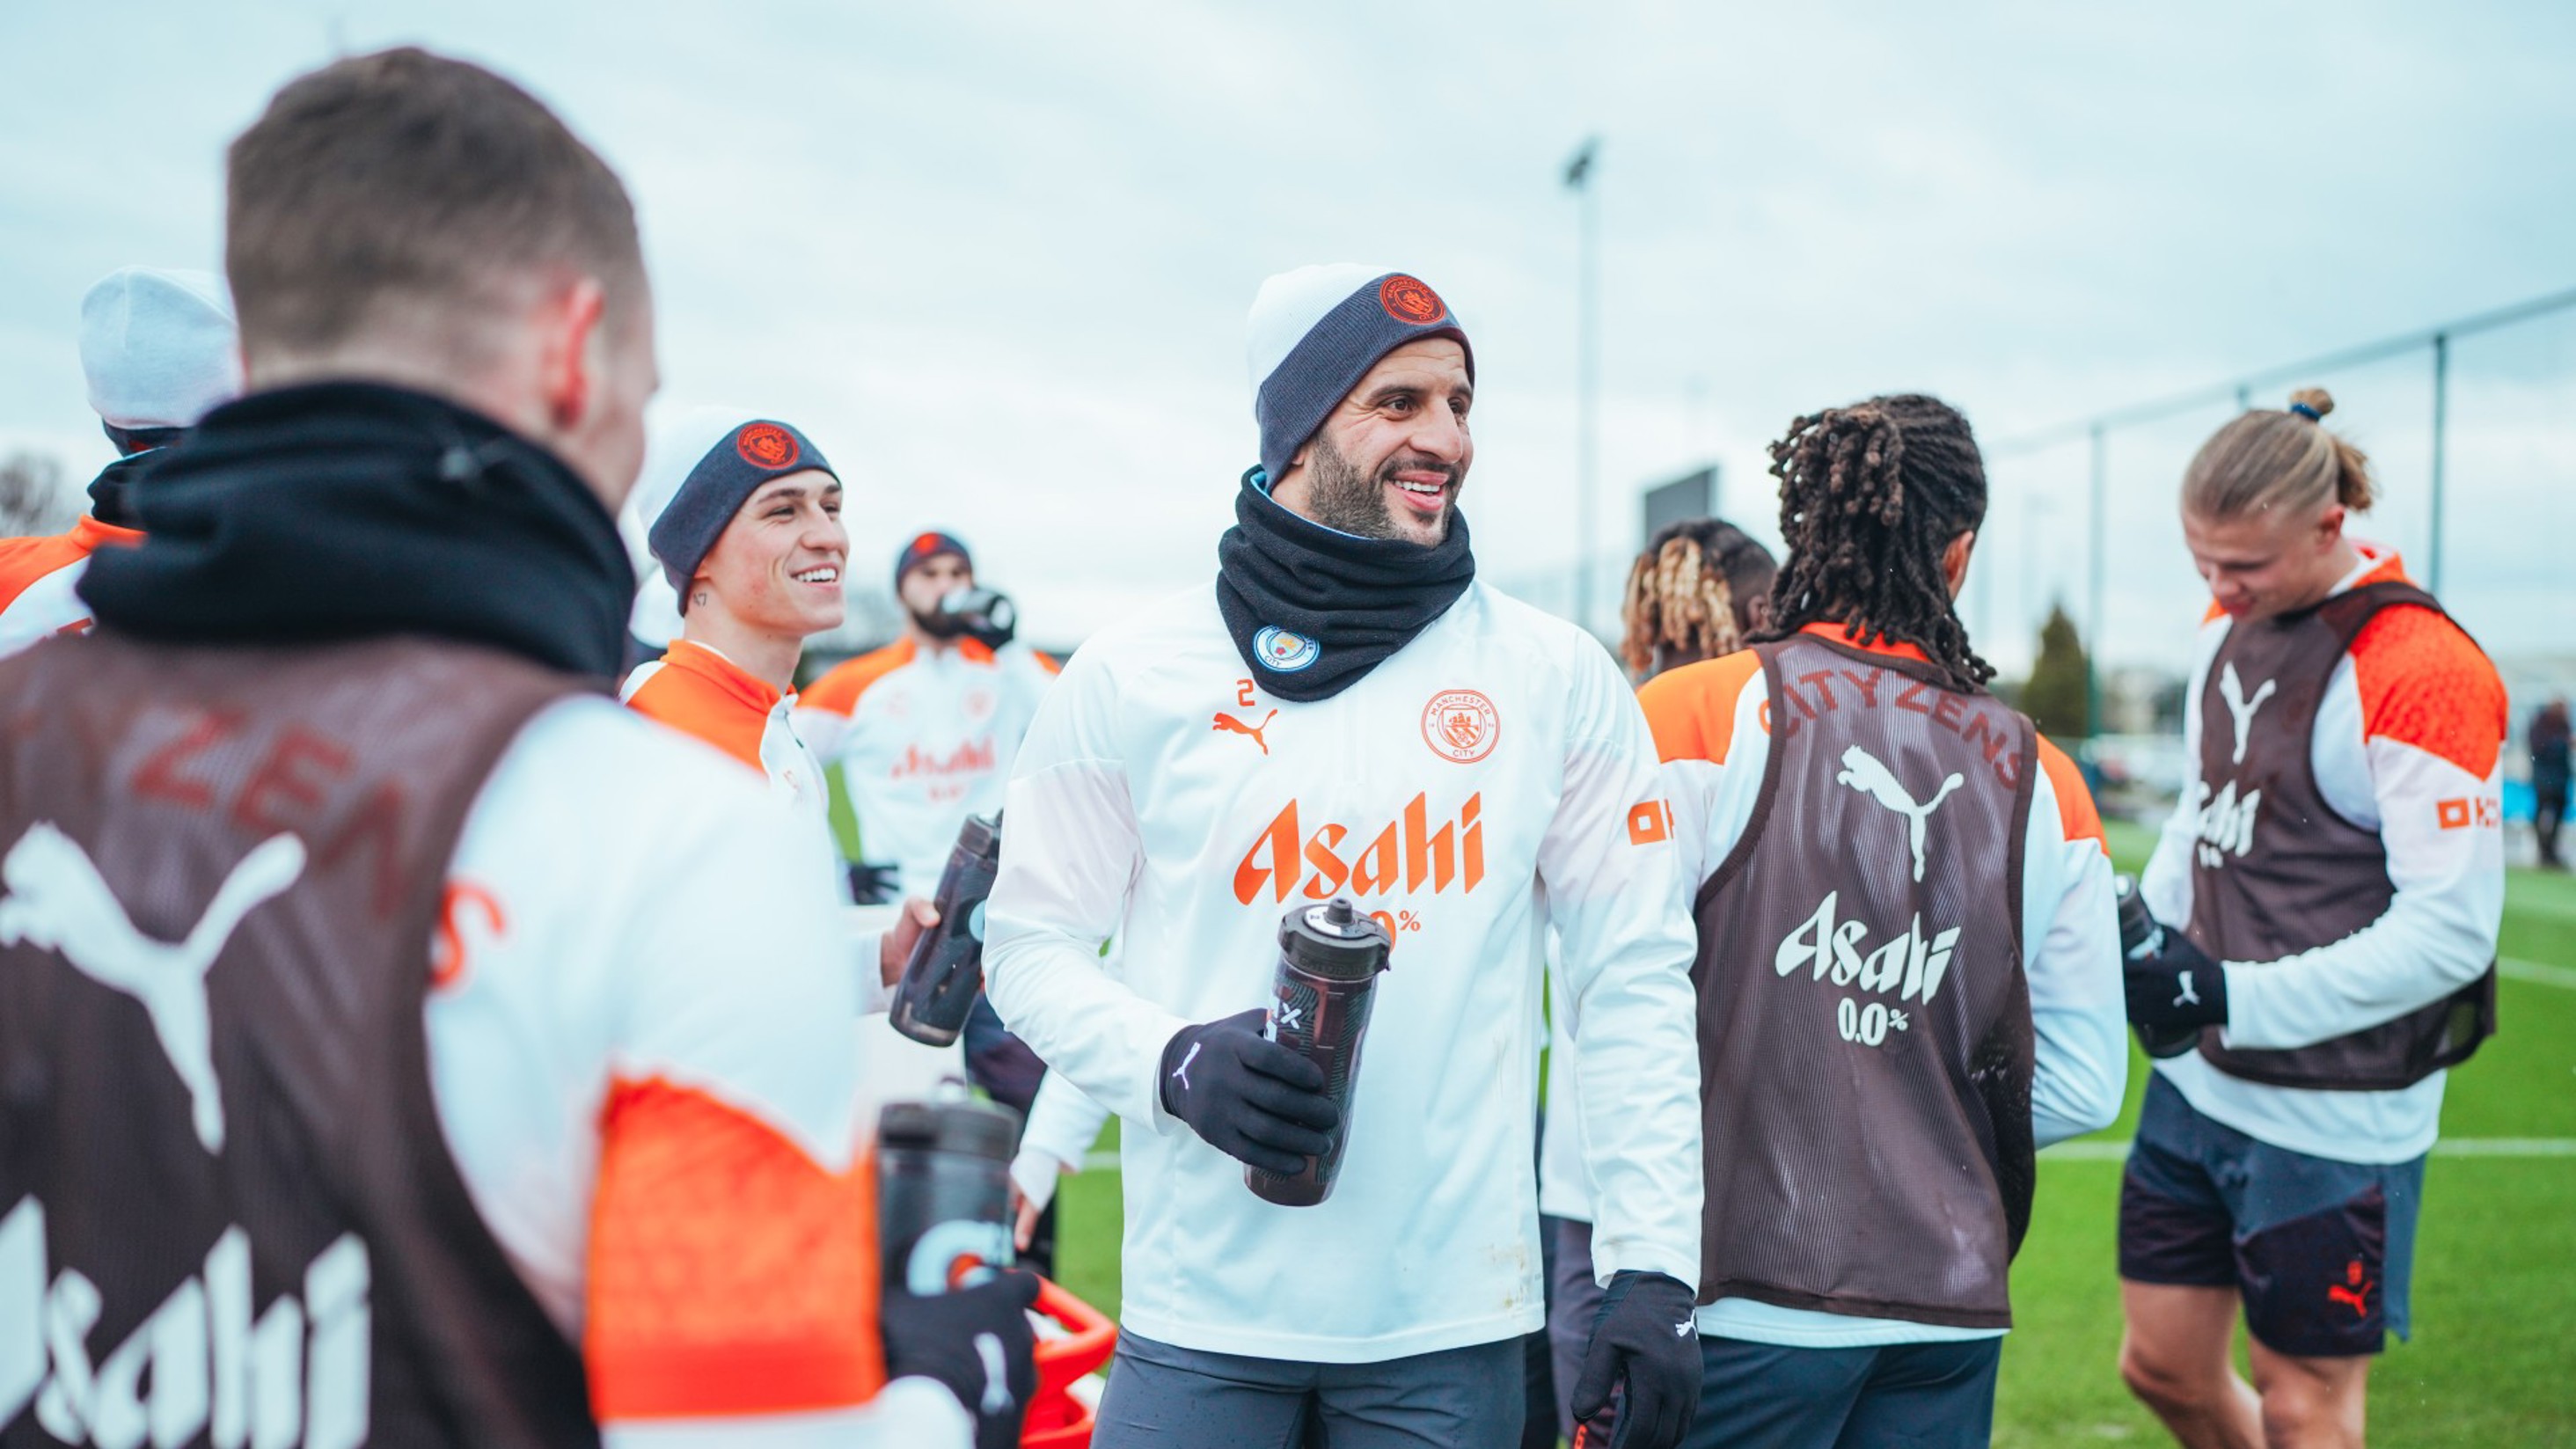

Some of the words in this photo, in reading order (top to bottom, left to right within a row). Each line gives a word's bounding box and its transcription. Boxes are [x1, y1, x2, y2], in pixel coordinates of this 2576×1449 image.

[1264, 655, 1282, 667] CITY
[1236, 678, 1255, 706] 2
[1431, 696, 1490, 715] MANCHESTER
[1759, 667, 2021, 790] CITYZENS
[1233, 791, 1484, 905] Asahi
[1775, 889, 1961, 1006] Asahi
[1837, 997, 1908, 1046] 0.0%
